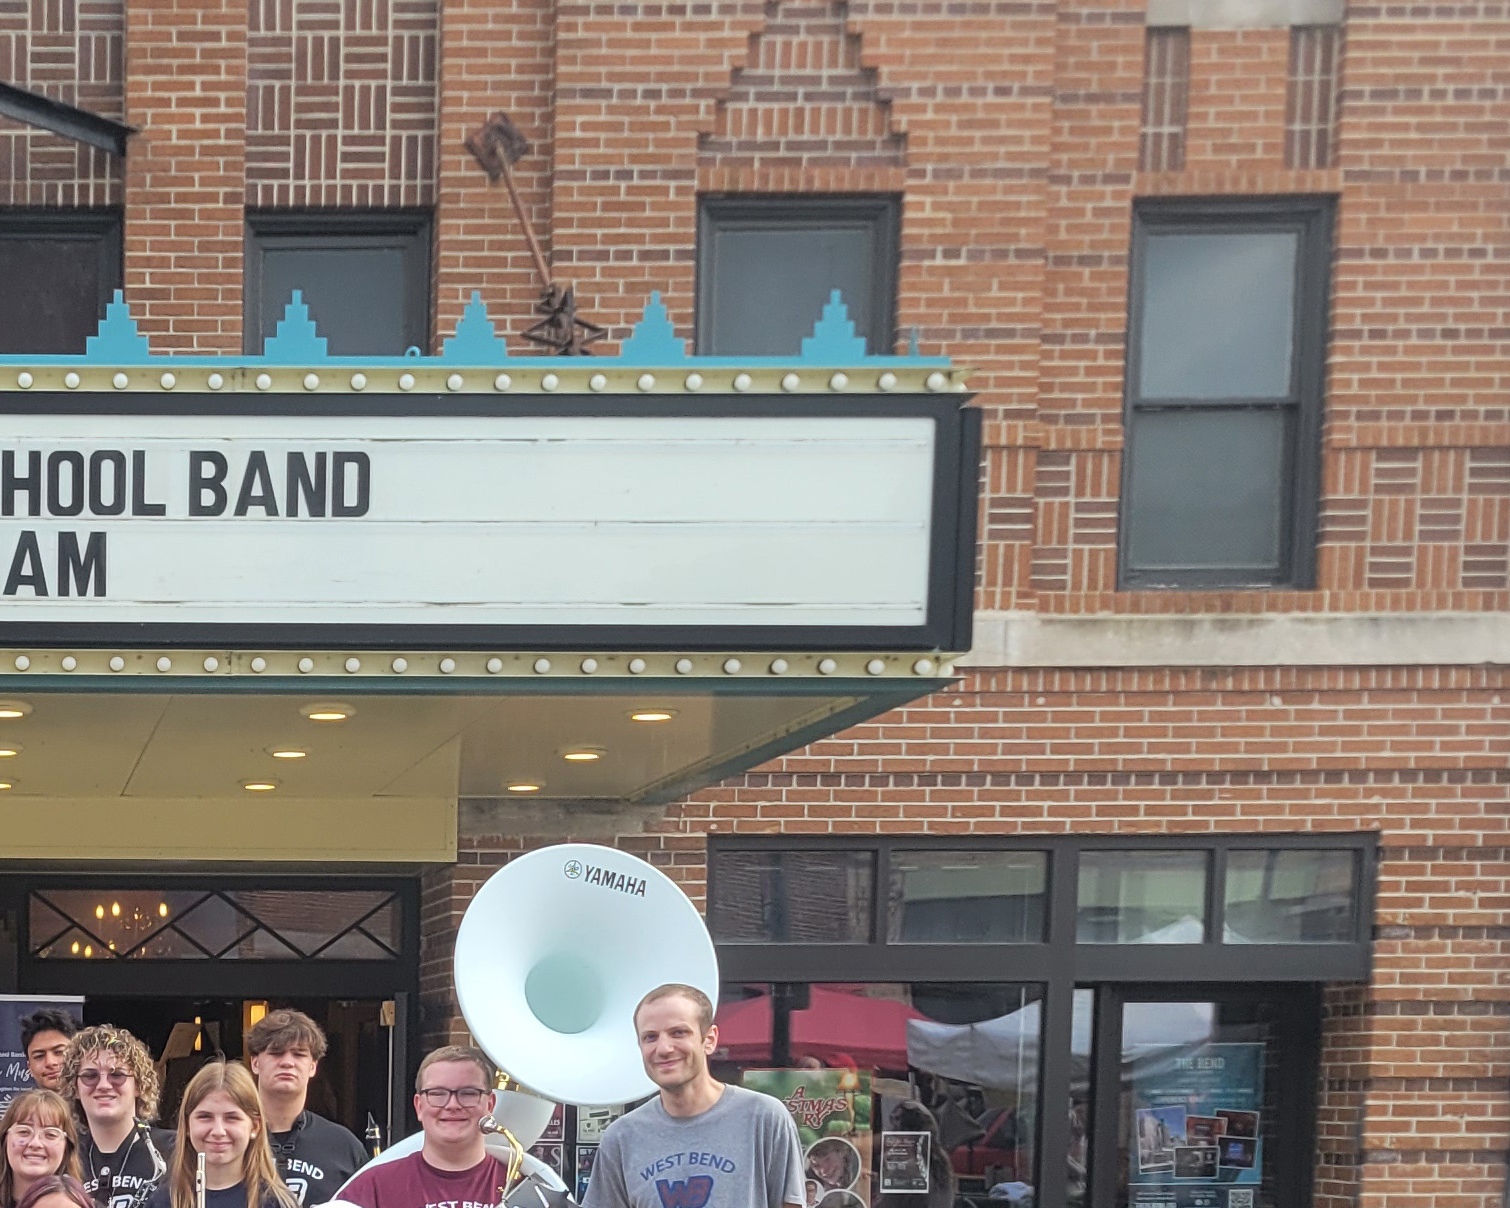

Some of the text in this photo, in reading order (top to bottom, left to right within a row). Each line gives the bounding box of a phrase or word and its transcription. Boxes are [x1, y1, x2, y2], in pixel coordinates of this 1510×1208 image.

[189, 451, 371, 518] BAND
[584, 864, 647, 897] YAMAHA
[640, 1152, 736, 1181] WEST BEND
